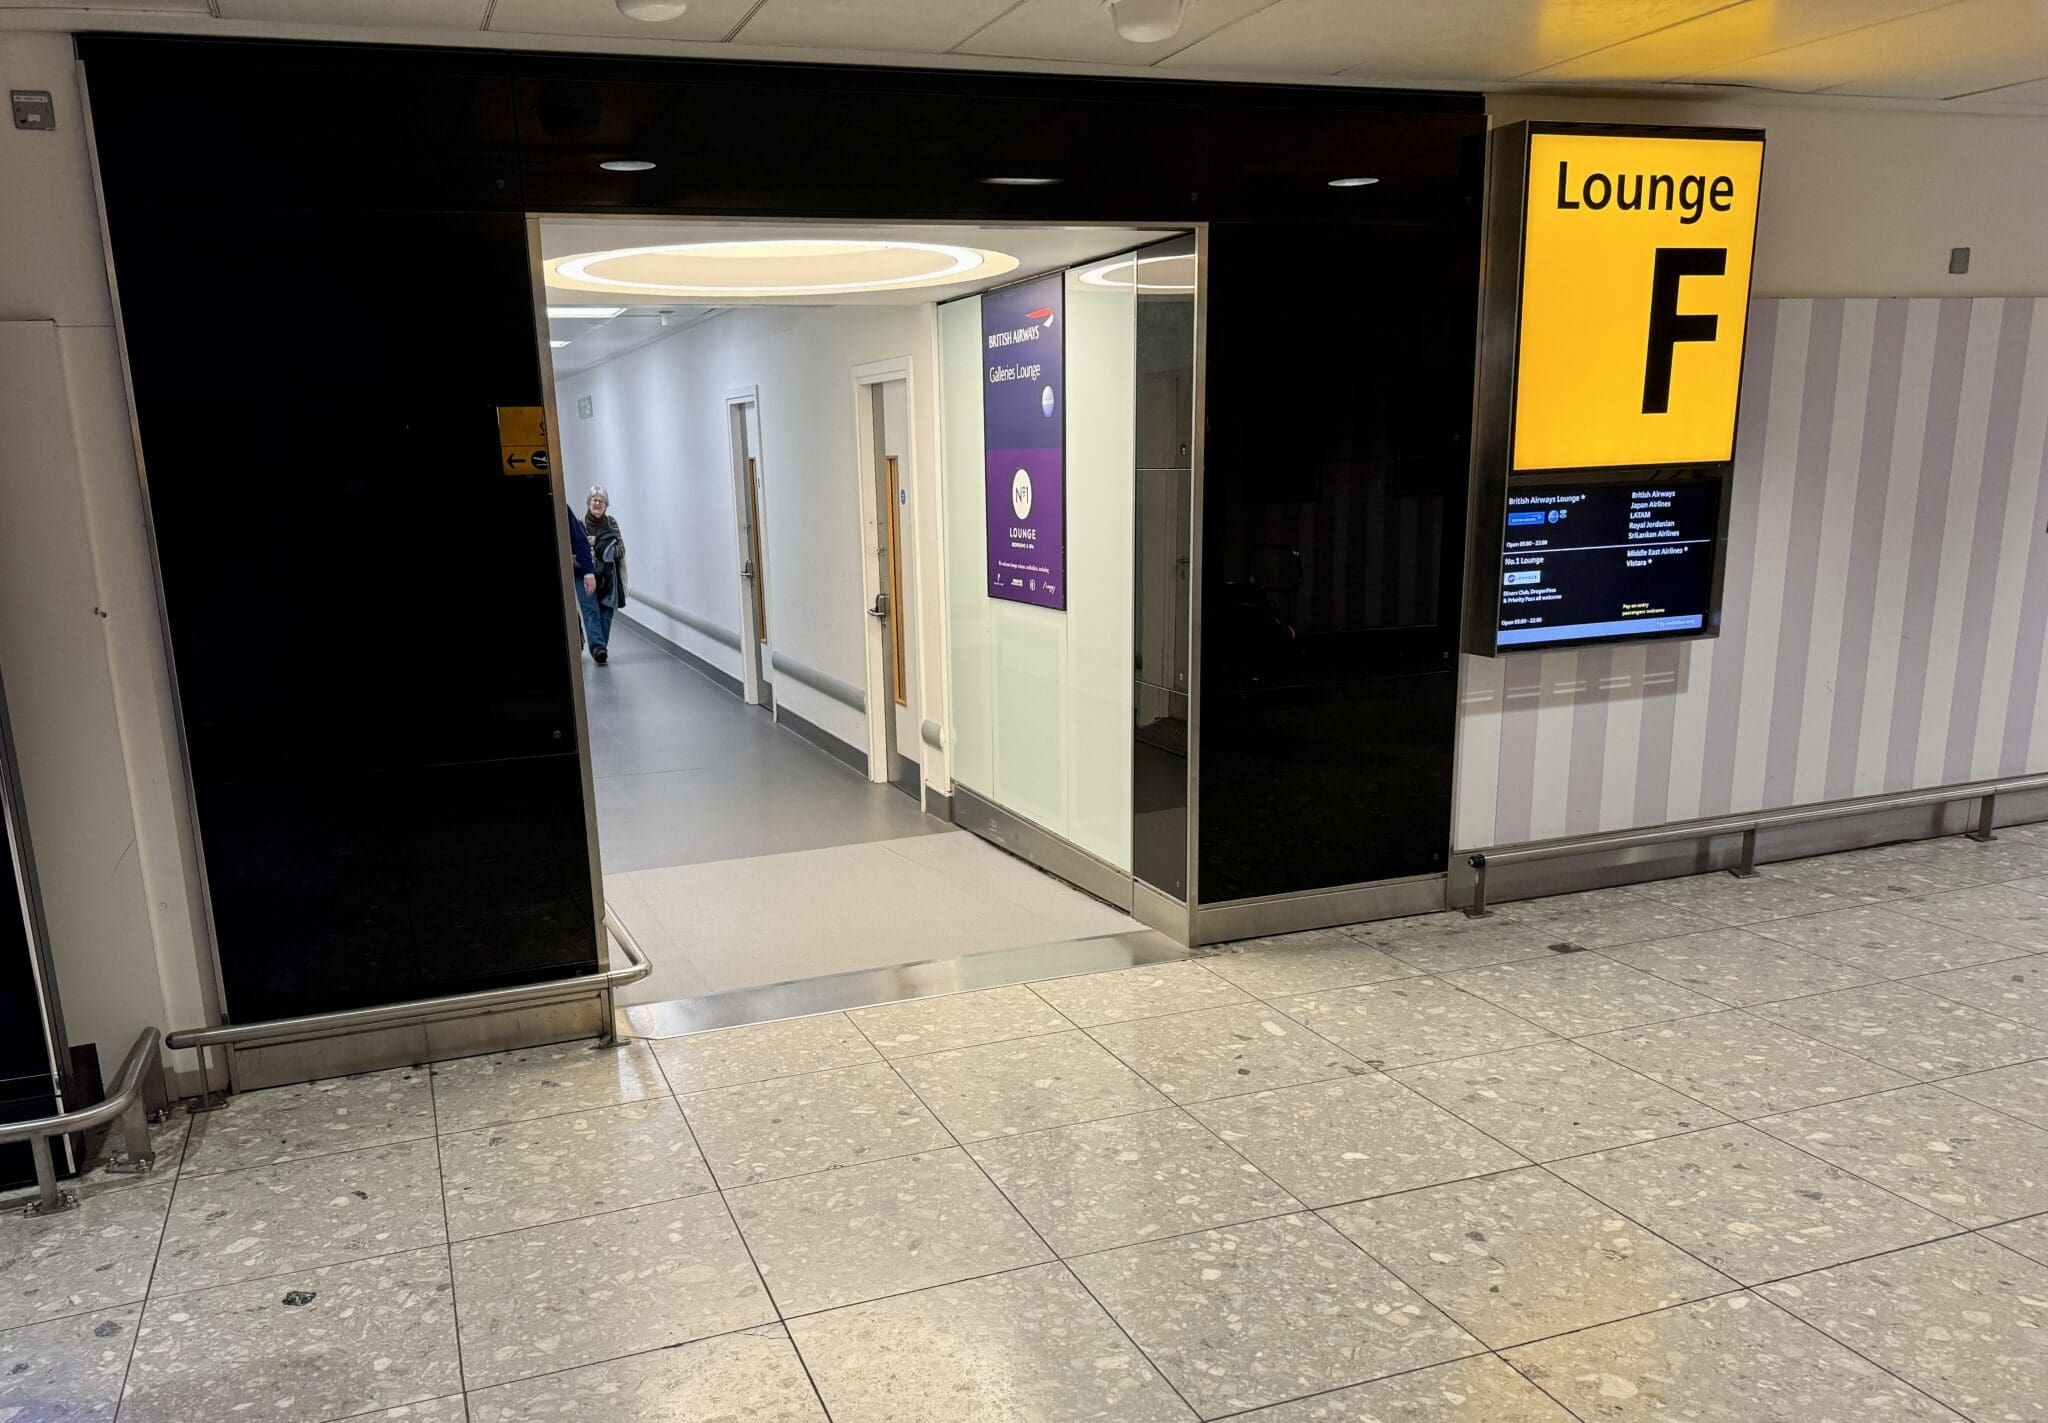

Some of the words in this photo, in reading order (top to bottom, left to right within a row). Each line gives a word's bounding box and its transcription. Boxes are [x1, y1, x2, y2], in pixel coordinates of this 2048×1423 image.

[1557, 161, 1734, 224] Lounge
[989, 331, 1012, 348] BRITISH
[1013, 326, 1039, 344] AIRWAYS
[1642, 248, 1727, 414] F
[990, 365, 1015, 383] Galleries
[1017, 363, 1040, 380] Lounge
[1509, 497, 1529, 505] British
[1530, 496, 1556, 504] Airways
[1631, 502, 1648, 510] Japan
[1629, 521, 1645, 530] Royal
[1646, 520, 1675, 528] Jordanian
[1009, 527, 1036, 540] LOUNGE
